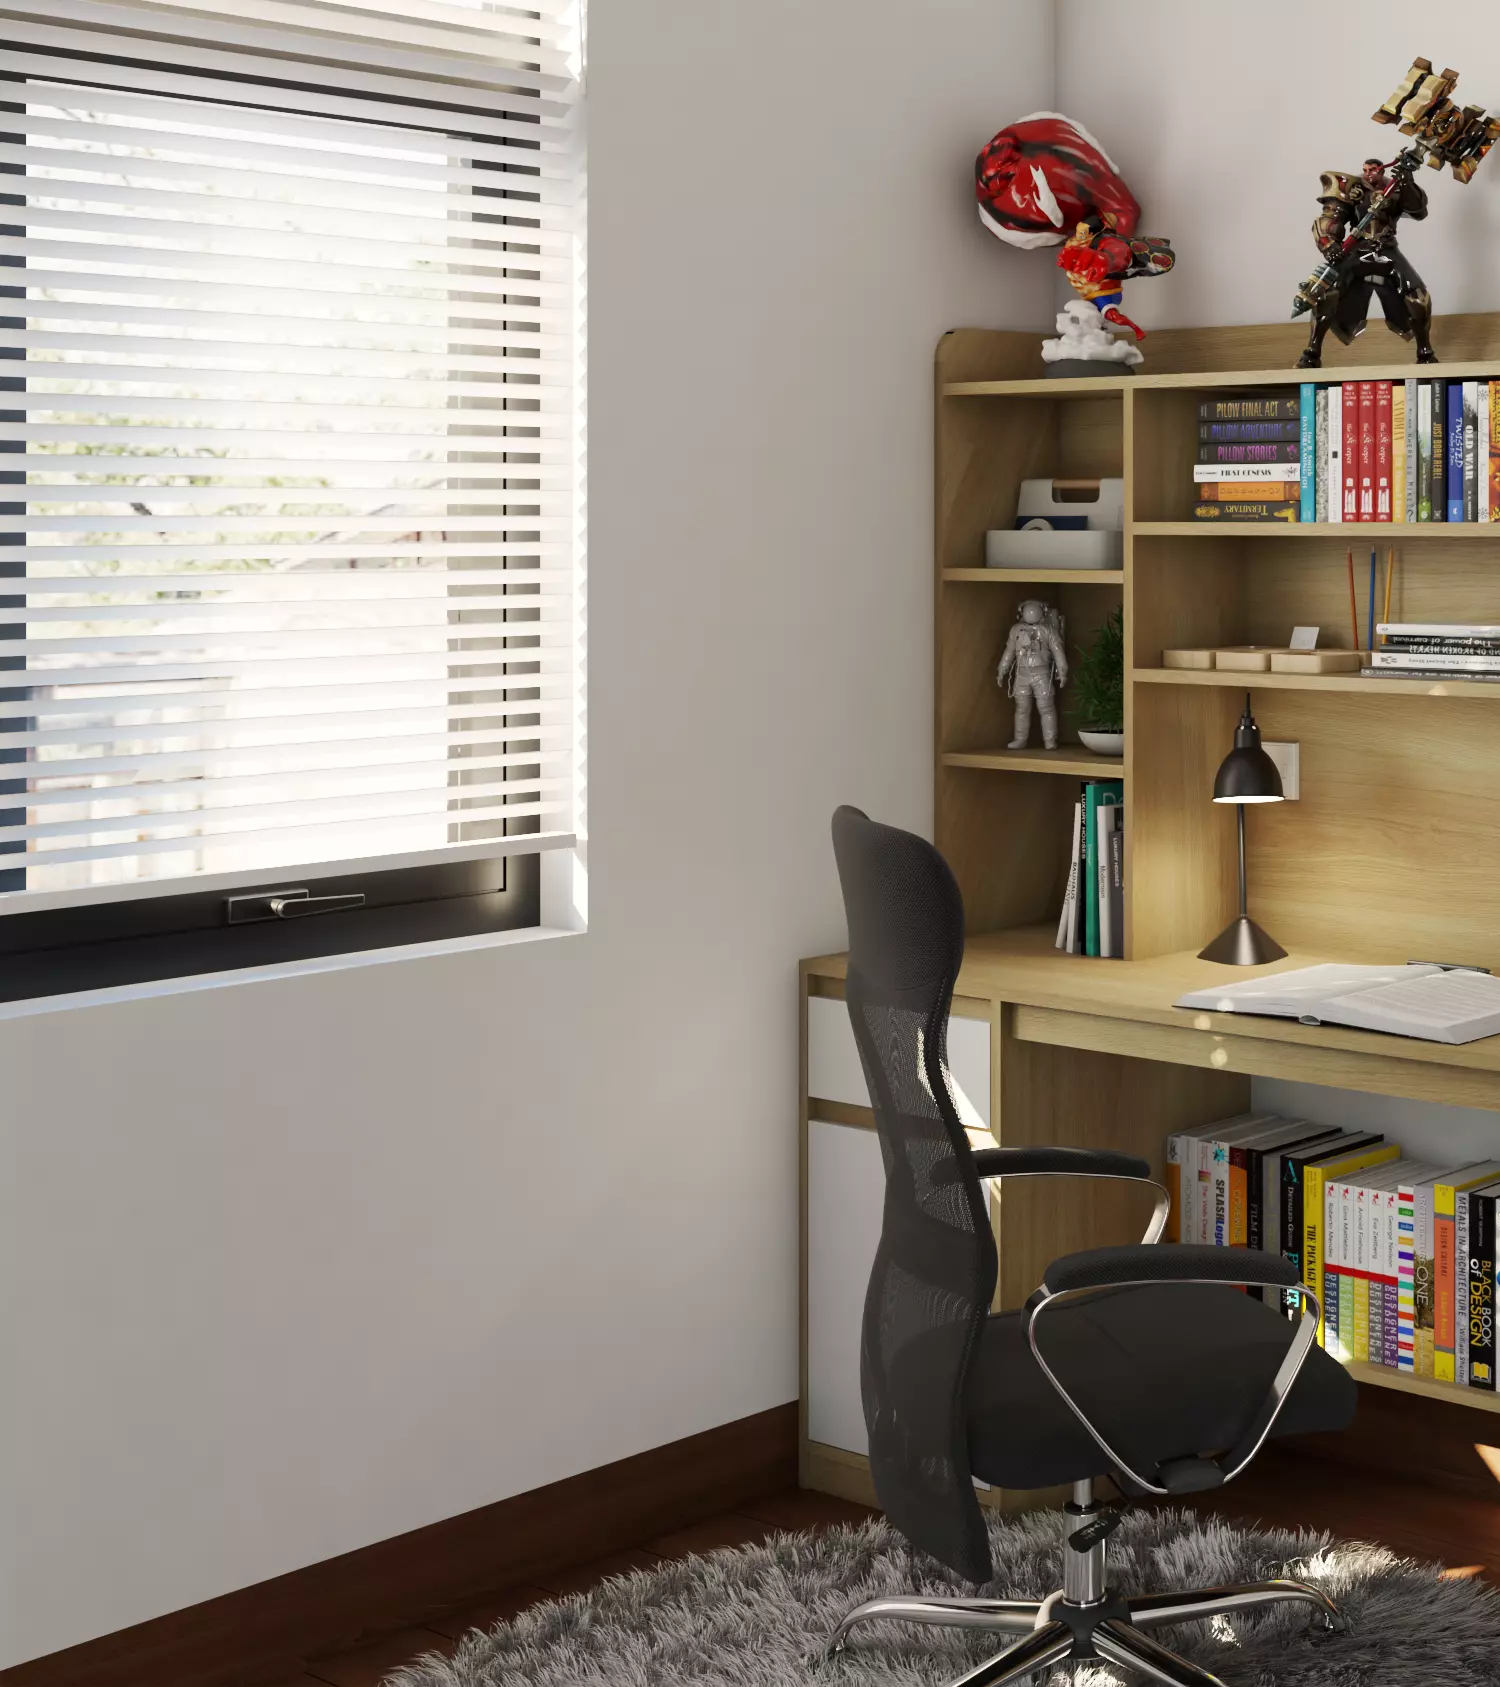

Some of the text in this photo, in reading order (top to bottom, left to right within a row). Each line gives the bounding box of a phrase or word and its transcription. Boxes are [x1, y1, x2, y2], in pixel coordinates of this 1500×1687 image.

[1241, 402, 1263, 418] FINAL
[1265, 401, 1279, 417] ACT
[1217, 445, 1245, 461] PILLOW
[1247, 445, 1277, 460] STORIES
[1433, 439, 1442, 459] BORN
[1454, 416, 1463, 468] TWISTED
[1465, 424, 1474, 480] OLD WAR
[1433, 459, 1442, 480] REBEL
[1112, 837, 1120, 860] LUXURY
[1070, 861, 1078, 900] BAUHAUS
[1099, 865, 1107, 899] Modernism
[1250, 1202, 1258, 1231] FILM
[1307, 1224, 1317, 1243] THE
[1439, 1226, 1448, 1249] DESIGN
[1457, 1195, 1467, 1317] METALS IN ARCHITECTURE
[1306, 1244, 1317, 1285] PACKAGE
[1470, 1258, 1482, 1275] of
[1481, 1260, 1491, 1304] BLACK
[1416, 1266, 1428, 1305] ONE
[1374, 1283, 1382, 1364] DESIGNER'S
[1383, 1284, 1391, 1365] GUIDELINES
[1389, 1286, 1397, 1367] DESIGNER'S
[1470, 1280, 1482, 1347] DESIGN
[1481, 1306, 1492, 1347] BOOK
